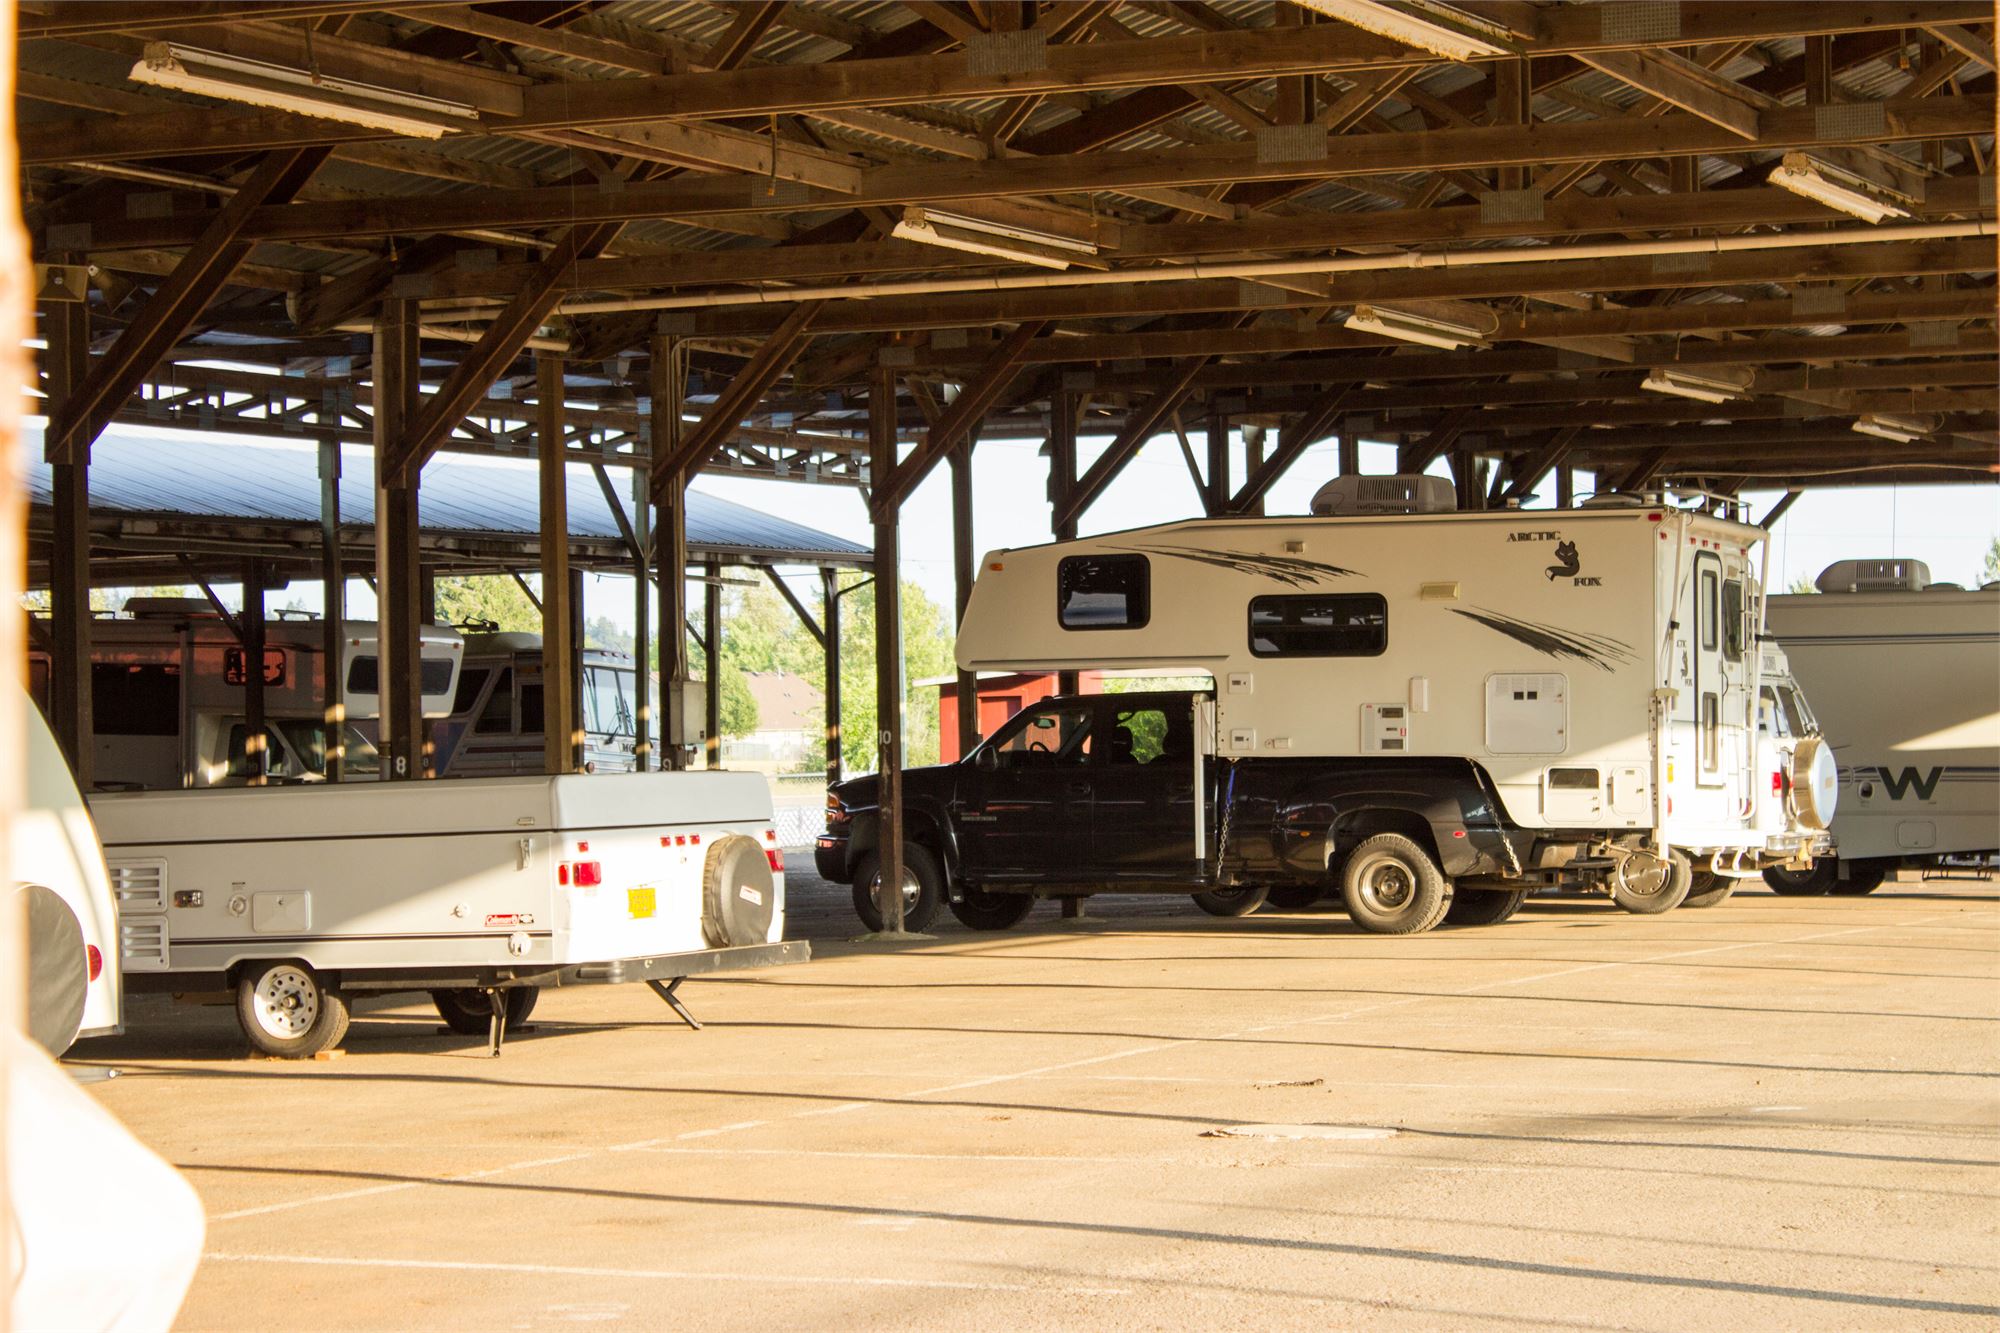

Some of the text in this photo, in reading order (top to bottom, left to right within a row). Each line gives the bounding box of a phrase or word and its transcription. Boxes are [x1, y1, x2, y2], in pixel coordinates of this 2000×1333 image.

[1506, 531, 1561, 542] ARCTIC
[1573, 577, 1602, 587] FOX
[879, 730, 892, 745] 10
[396, 756, 406, 774] 8
[1877, 767, 1944, 800] W
